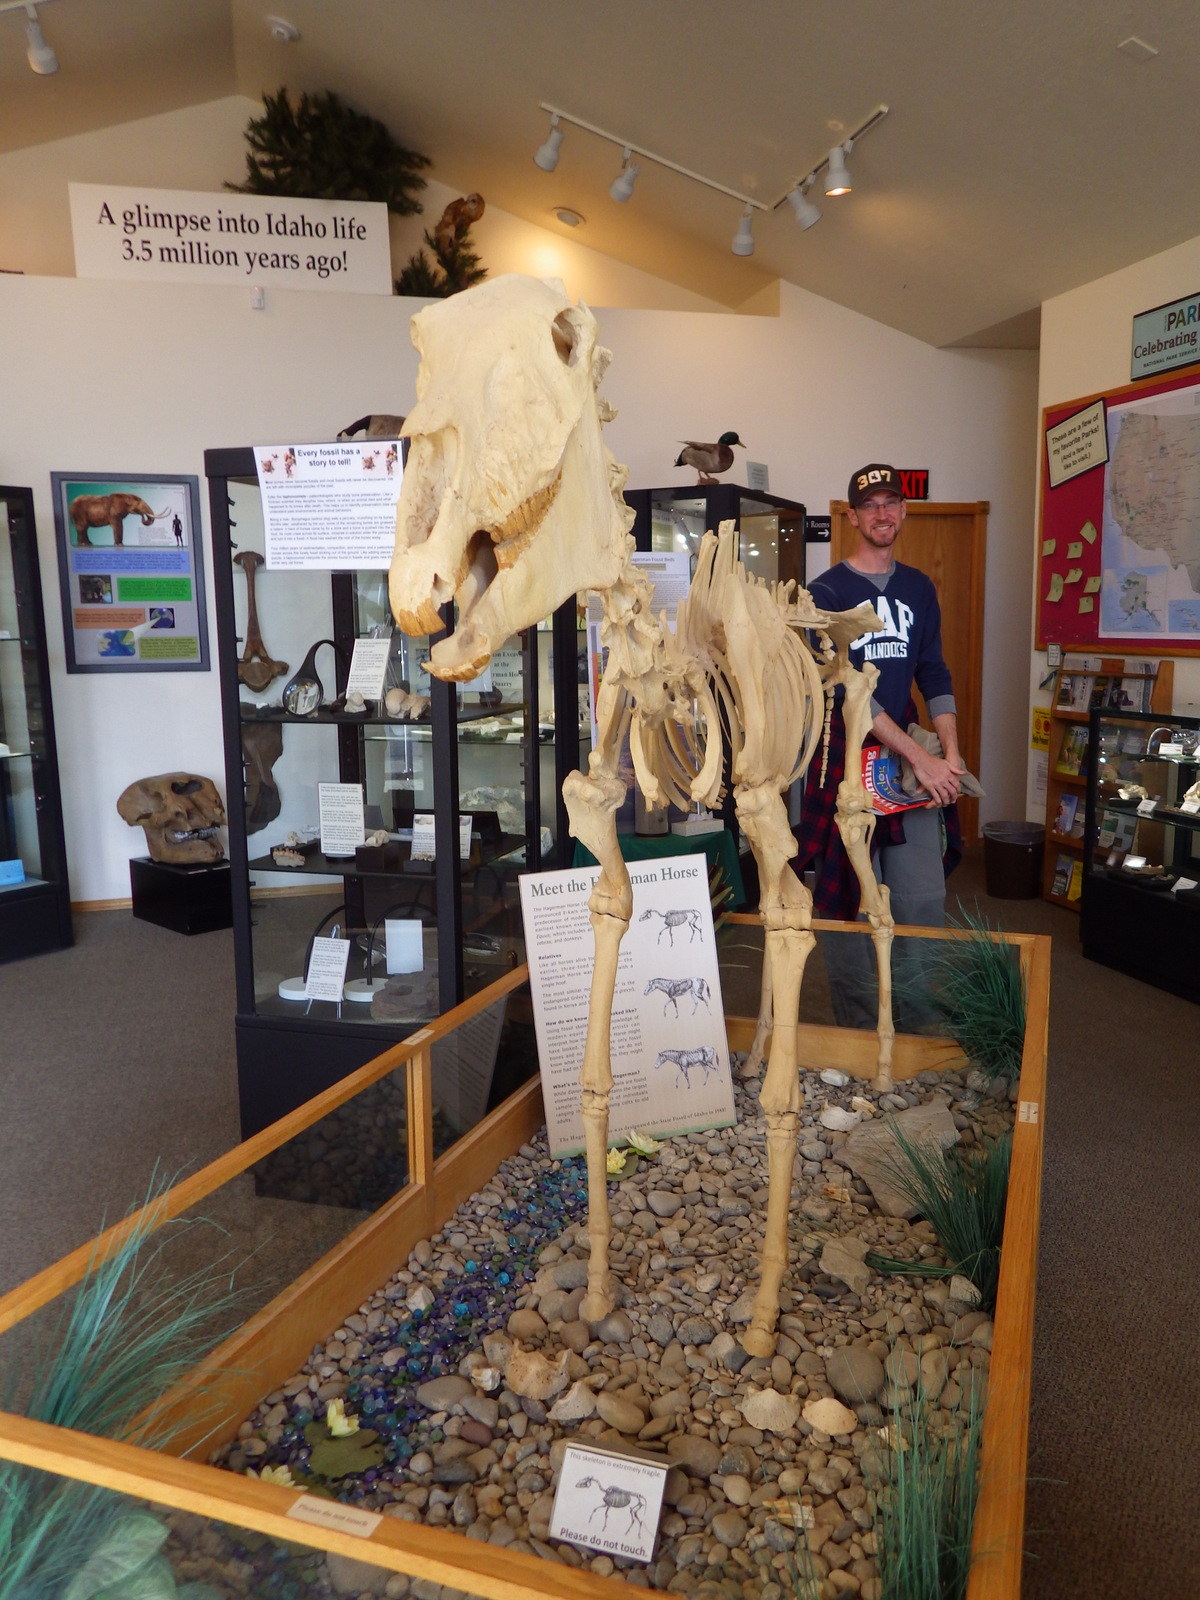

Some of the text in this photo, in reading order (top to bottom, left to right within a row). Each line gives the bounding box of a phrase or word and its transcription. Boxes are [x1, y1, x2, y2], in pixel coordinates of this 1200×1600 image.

[98, 202, 367, 240] A glimpse into Idaho life
[122, 239, 348, 278] 3.5 million years ago!
[1134, 331, 1197, 358] Celebrating
[1143, 358, 1165, 367] NATIONAL
[1179, 348, 1197, 357] SERVICE
[1052, 433, 1067, 444] These
[1068, 427, 1076, 436] are
[1082, 419, 1091, 427] few
[1093, 413, 1098, 422] of
[1061, 437, 1080, 450] favorite
[1082, 425, 1099, 439] Parks!
[309, 459, 327, 467] story
[857, 470, 891, 490] 307
[896, 471, 927, 498] XIT
[531, 883, 563, 897] Meet
[568, 880, 586, 892] the
[661, 867, 698, 880] Horse
[561, 964, 589, 972] three-toed
[543, 997, 569, 1005] endangered
[613, 1070, 640, 1078] Hagerman?
[625, 1122, 650, 1130] designated
[582, 1454, 606, 1465] skeleton
[613, 1462, 641, 1473] extremely
[642, 1468, 661, 1478] fragile.
[560, 1527, 648, 1558] Please do not touch.
